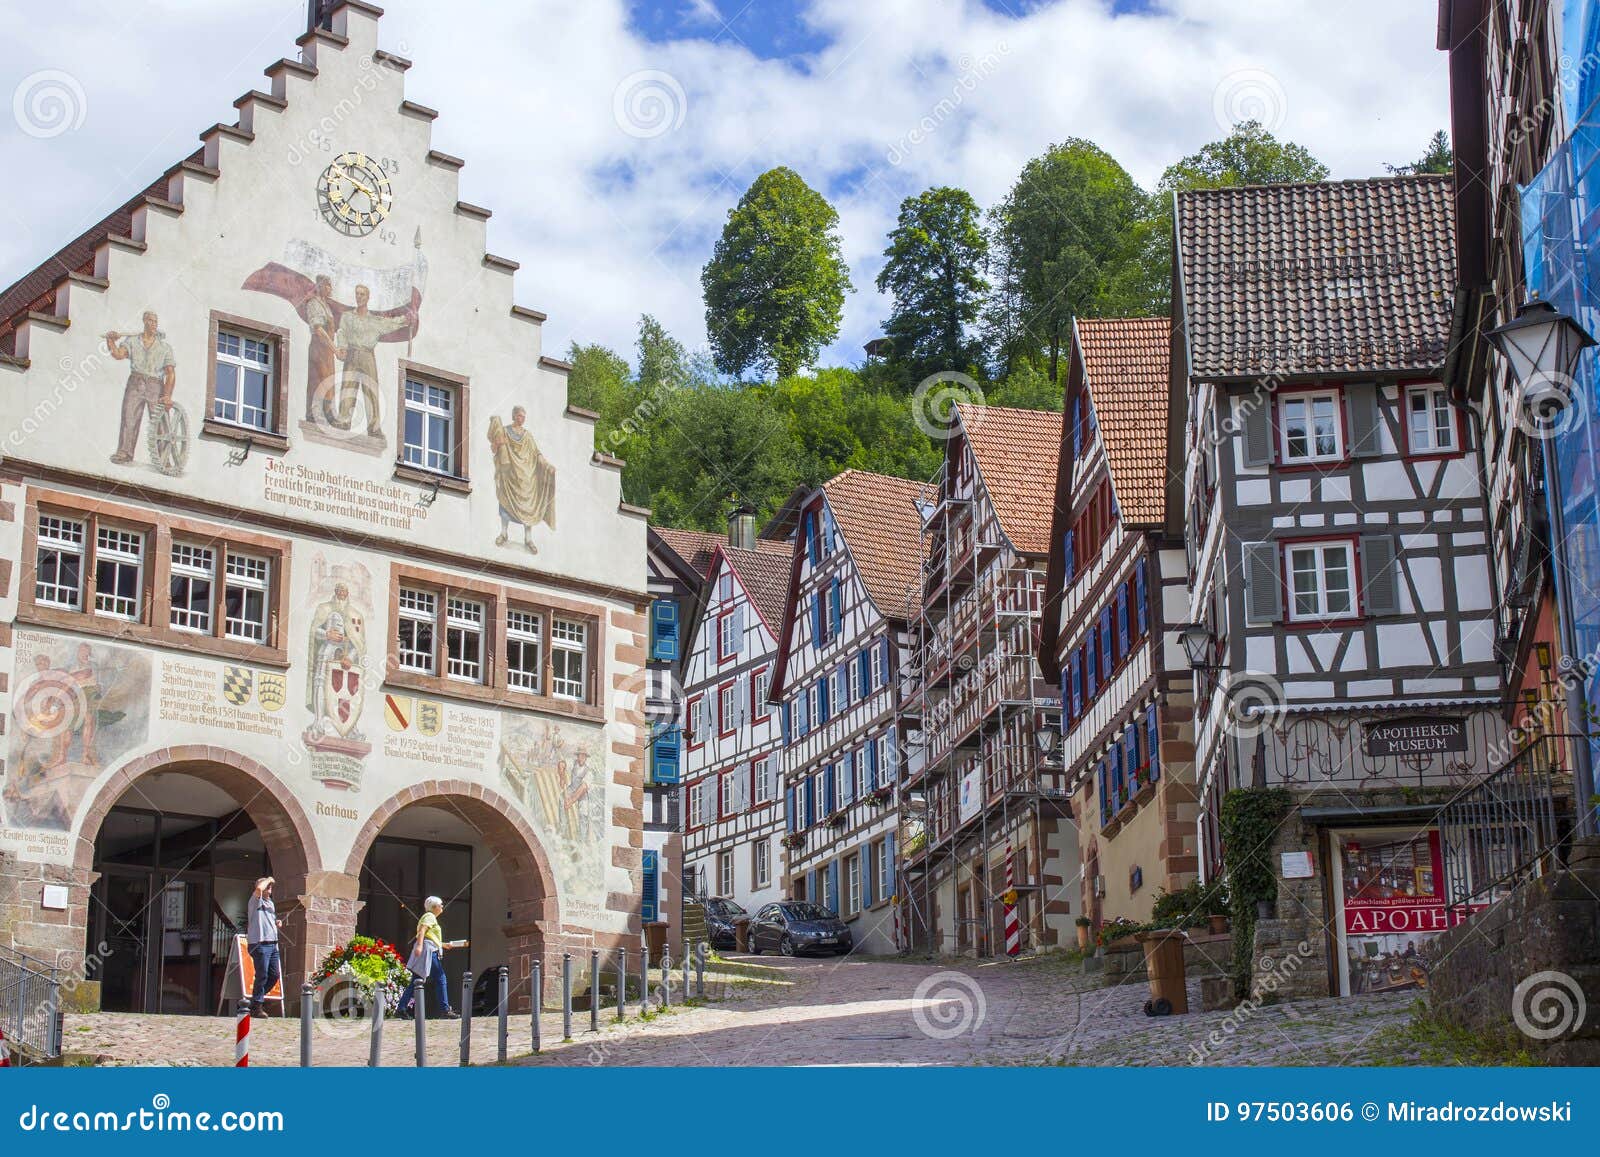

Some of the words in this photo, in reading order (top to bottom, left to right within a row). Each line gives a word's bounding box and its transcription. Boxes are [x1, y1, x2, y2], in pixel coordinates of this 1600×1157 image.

[264, 457, 295, 476] Jeder
[296, 464, 325, 482] Stand
[1372, 724, 1459, 740] APOTHEKEN
[1389, 738, 1447, 752] MUSEUM
[316, 801, 359, 820] Rathaus
[1347, 897, 1391, 906] Deutschlands
[1416, 897, 1442, 905] privates
[1349, 907, 1480, 931] APOTHE
